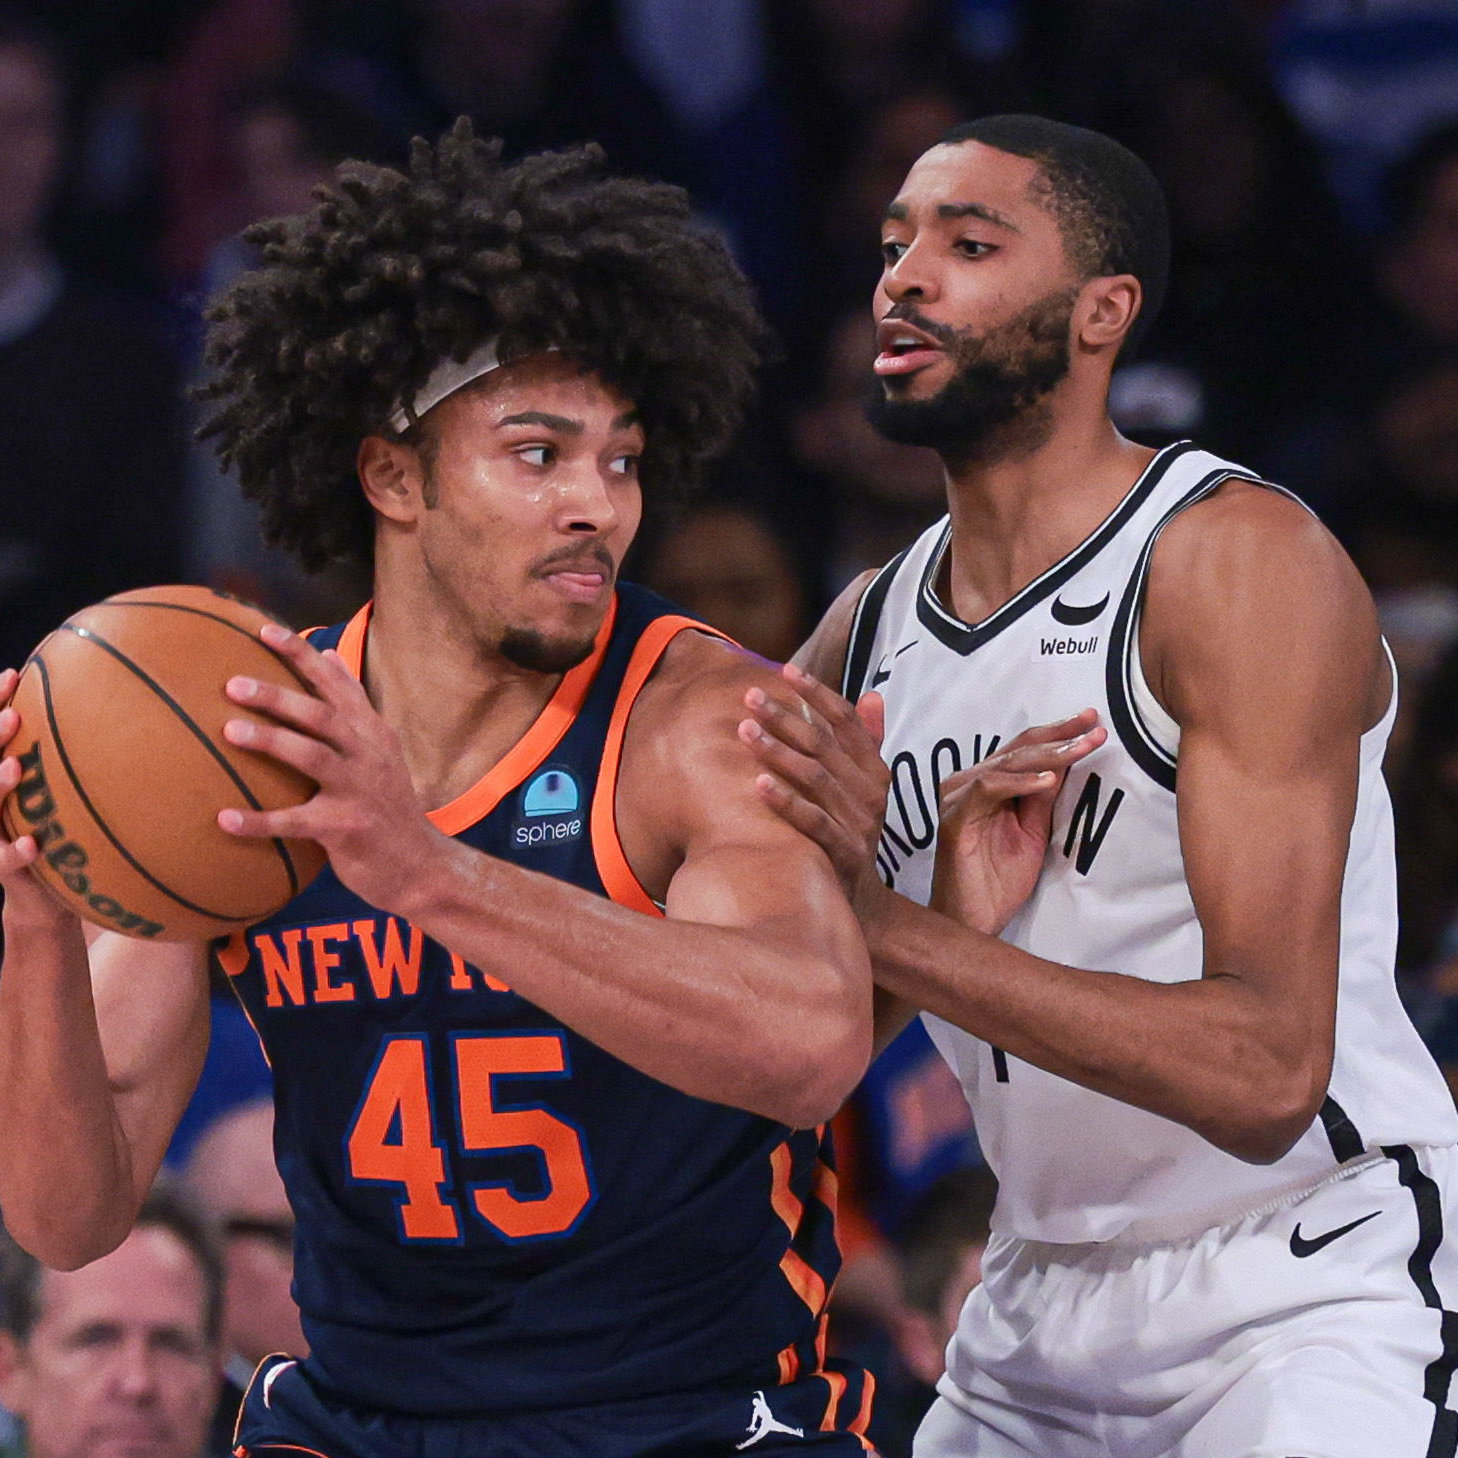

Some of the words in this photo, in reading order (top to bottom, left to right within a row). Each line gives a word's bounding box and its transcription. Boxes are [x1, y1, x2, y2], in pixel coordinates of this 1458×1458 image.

[1039, 636, 1099, 657] Webull
[516, 819, 581, 845] sphere
[254, 916, 424, 1007] NEW
[346, 1031, 597, 1243] 45
